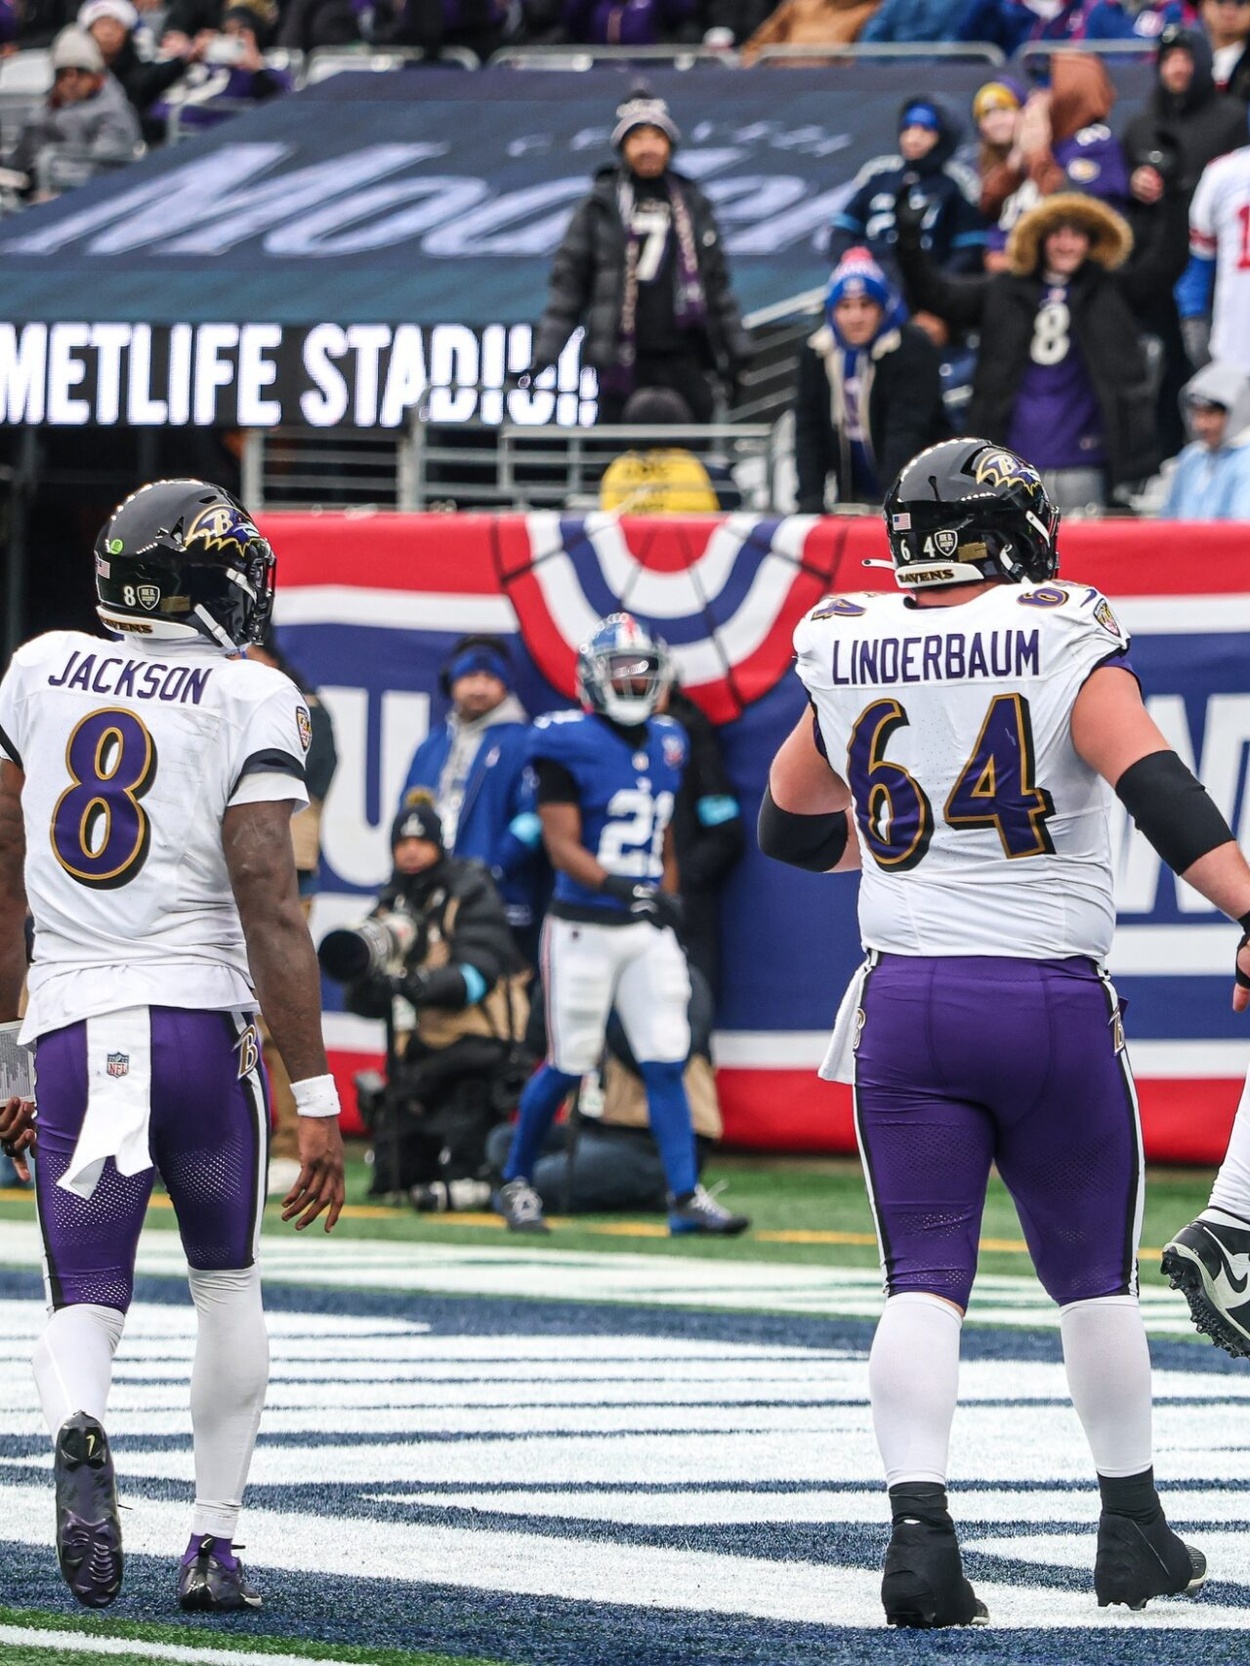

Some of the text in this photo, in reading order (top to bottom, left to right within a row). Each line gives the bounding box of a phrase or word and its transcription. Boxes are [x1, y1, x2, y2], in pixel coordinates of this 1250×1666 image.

[632, 213, 670, 282] 7
[1031, 302, 1070, 366] 8
[0, 322, 283, 427] METLIFE
[901, 540, 911, 561] 6
[923, 536, 935, 557] 4
[124, 585, 136, 607] 8
[48, 650, 212, 705] JACKSON
[832, 629, 1040, 685] LINDERBAUM
[50, 706, 158, 890] 8
[847, 692, 1057, 872] 64
[596, 788, 676, 878] 21
